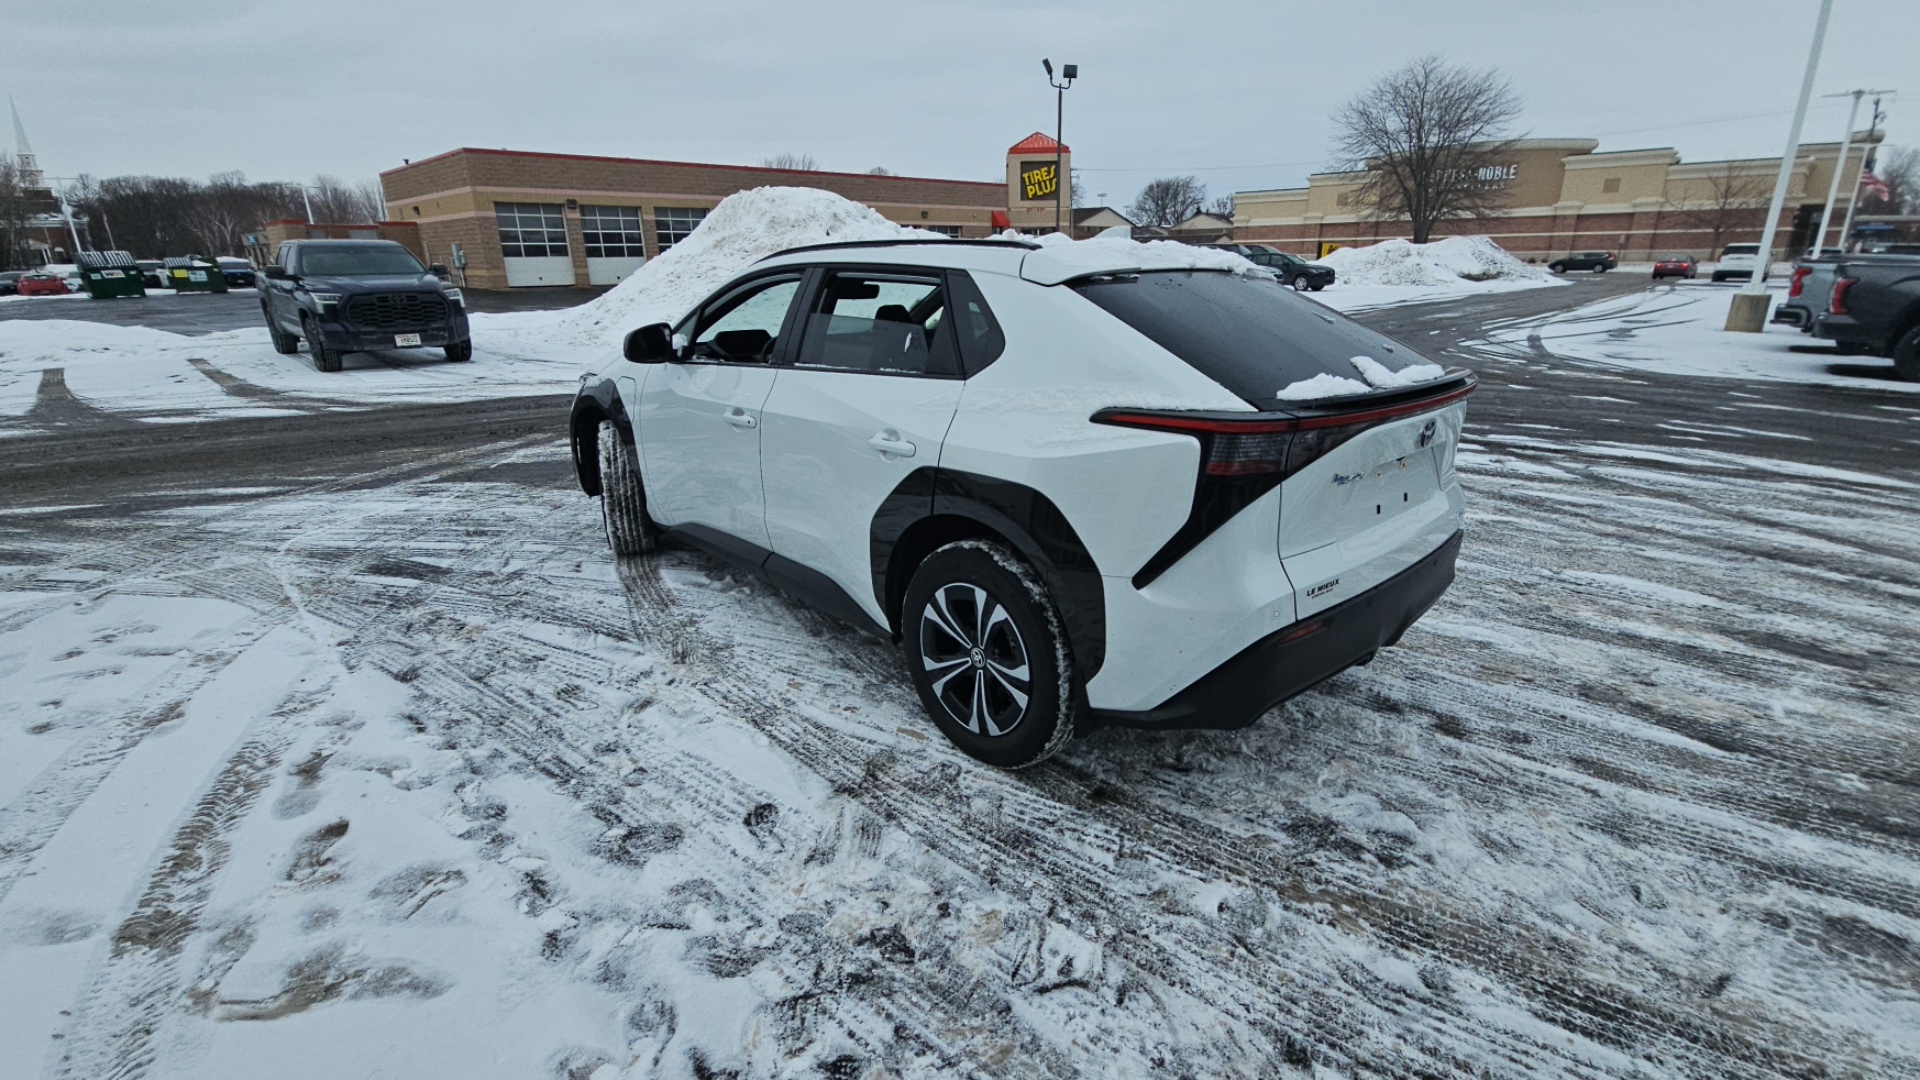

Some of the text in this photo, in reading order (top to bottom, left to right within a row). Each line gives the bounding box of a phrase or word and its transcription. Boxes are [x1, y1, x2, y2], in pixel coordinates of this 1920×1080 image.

[1022, 164, 1056, 185] TIRES
[1477, 164, 1517, 181] NOBLE
[1026, 177, 1057, 198] PLUS
[1306, 587, 1316, 597] LE
[1316, 578, 1340, 593] MIEUX
